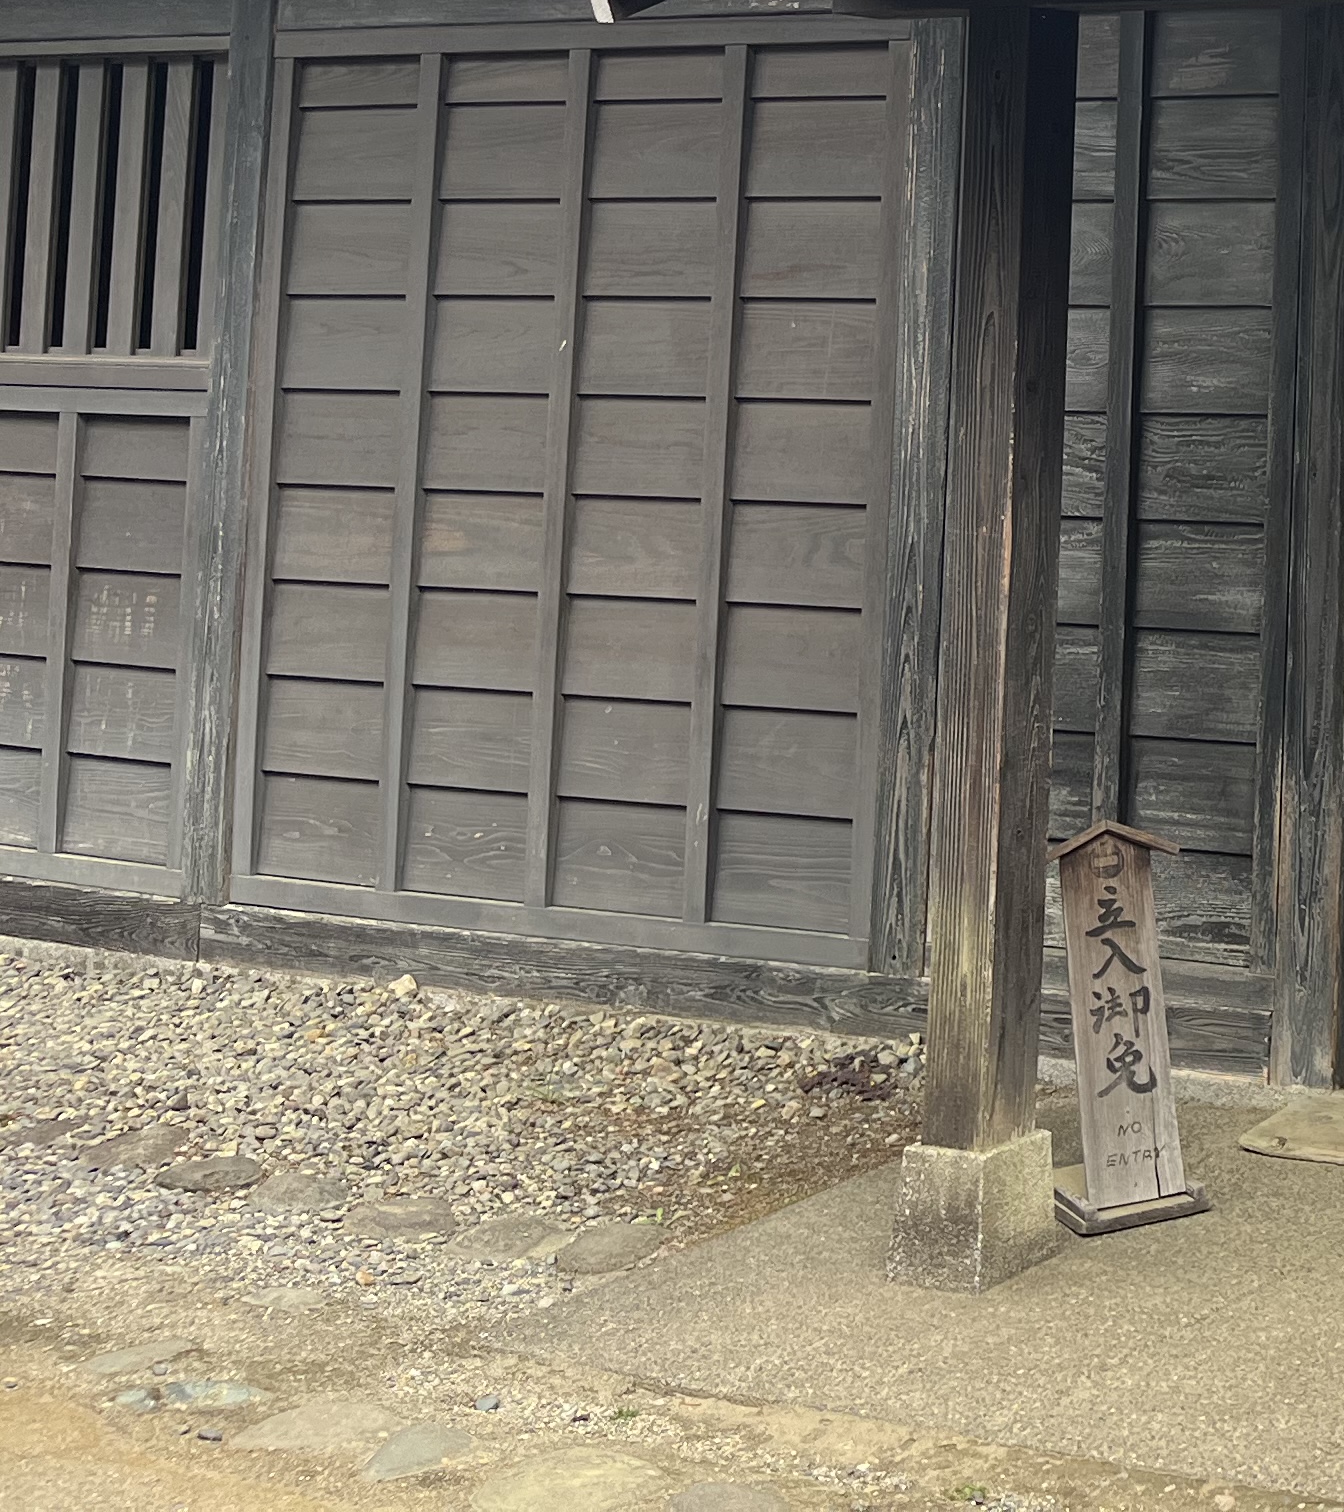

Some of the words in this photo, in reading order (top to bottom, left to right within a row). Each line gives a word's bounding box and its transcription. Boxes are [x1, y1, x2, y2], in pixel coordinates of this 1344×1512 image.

[1085, 885, 1158, 1098] 立入御免
[1117, 1121, 1142, 1137] NO
[1106, 1144, 1166, 1167] ENTRY
